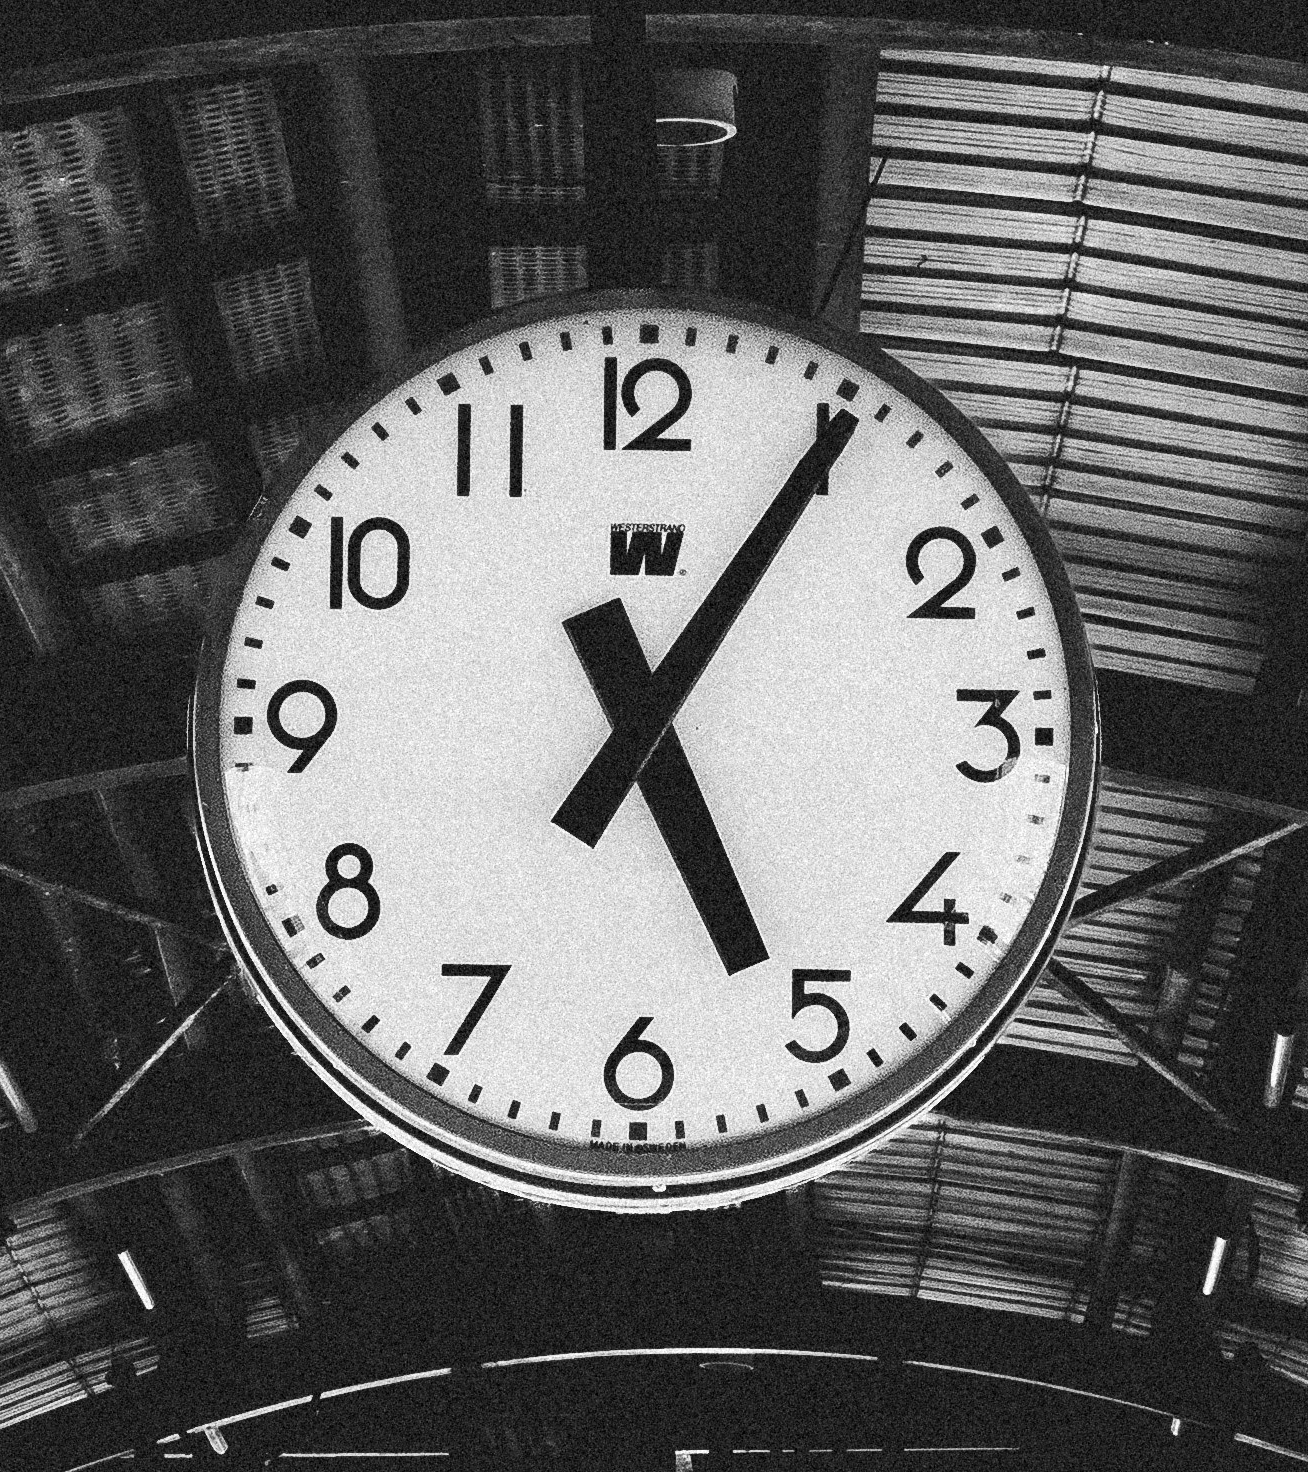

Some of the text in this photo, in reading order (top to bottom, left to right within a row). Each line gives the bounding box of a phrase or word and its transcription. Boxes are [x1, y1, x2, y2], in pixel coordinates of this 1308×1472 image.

[457, 404, 523, 497] 11
[604, 356, 692, 451] 12
[330, 517, 410, 610] 10
[906, 526, 976, 620] 2
[267, 680, 337, 774] 9
[956, 689, 1020, 783] 3
[316, 843, 380, 940] 8
[887, 852, 969, 946] 4
[442, 964, 512, 1055] 7
[785, 969, 851, 1063] 5
[604, 1017, 674, 1110] 6
